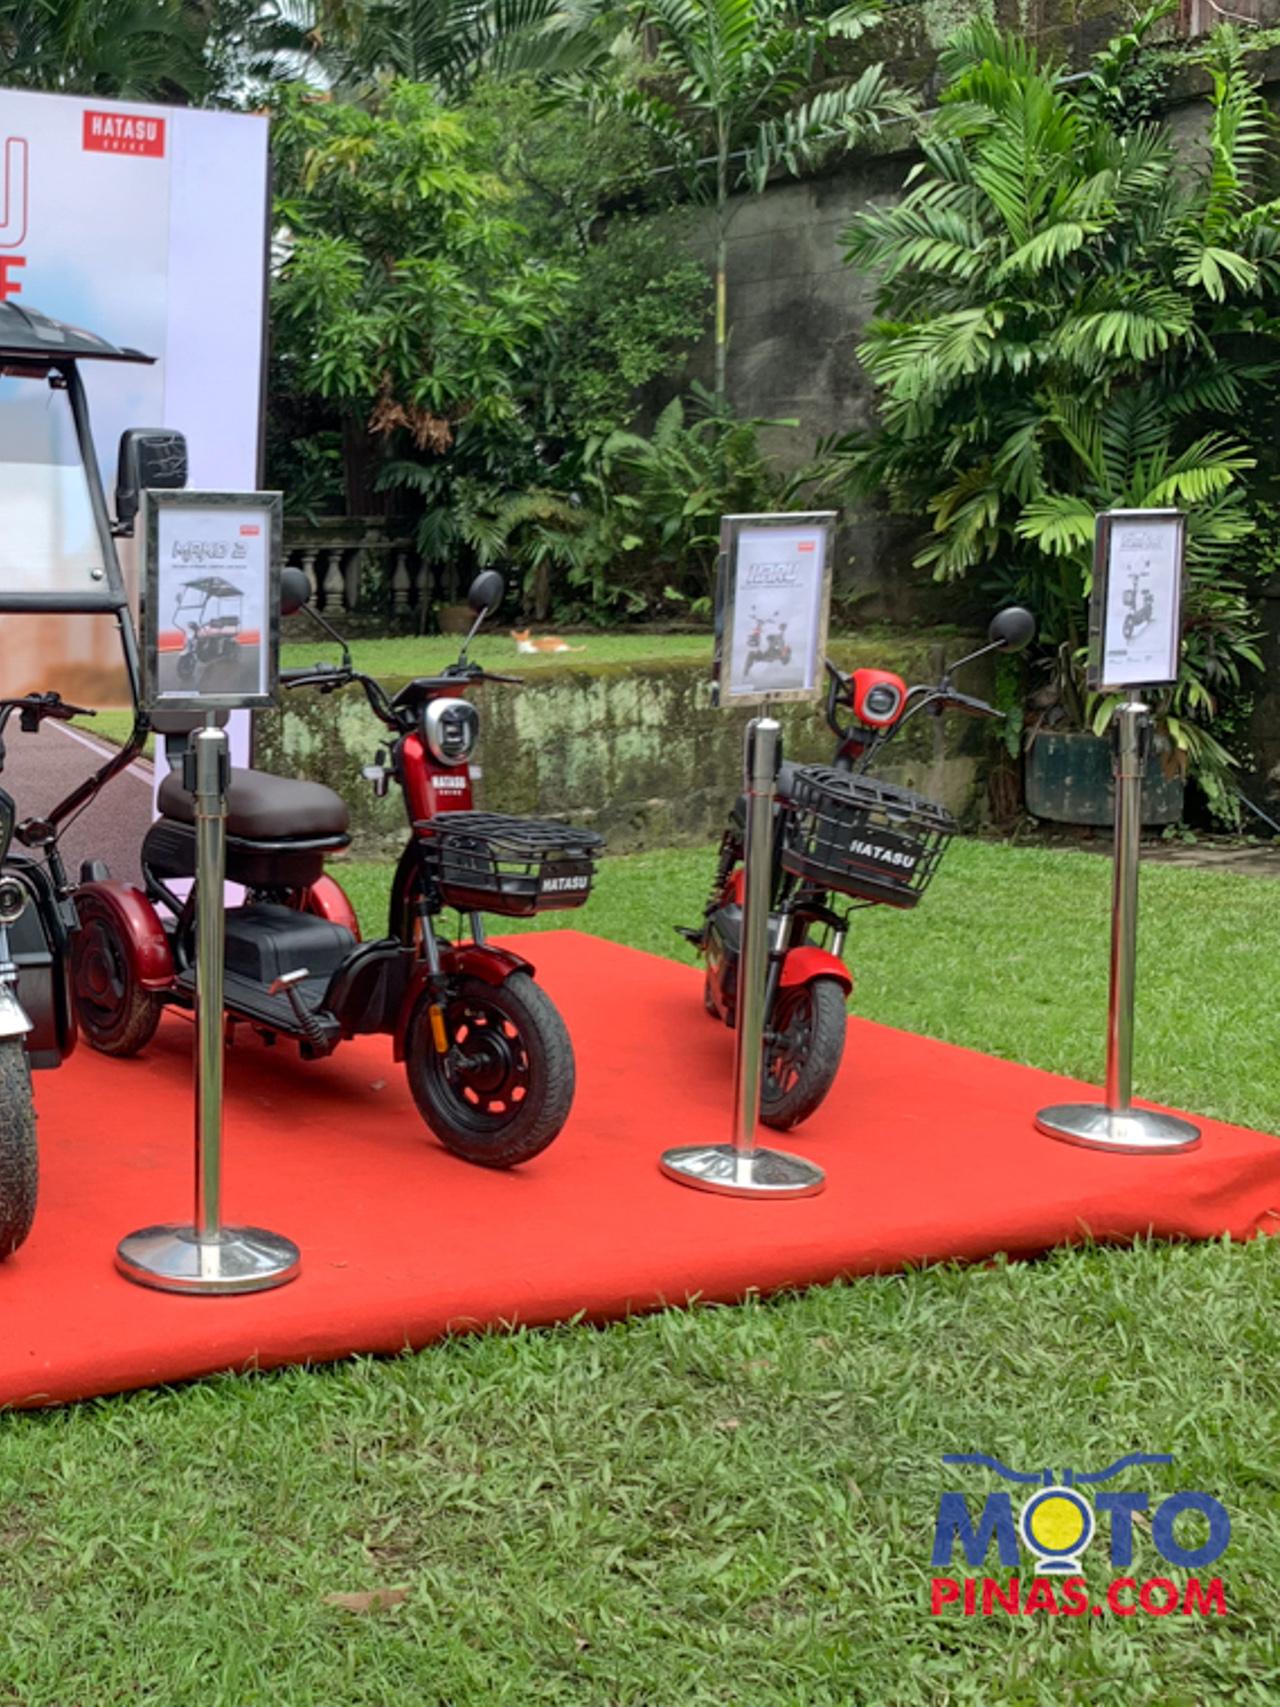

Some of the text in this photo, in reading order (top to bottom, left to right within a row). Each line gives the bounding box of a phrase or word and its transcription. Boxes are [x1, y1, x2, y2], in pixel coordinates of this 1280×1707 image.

[92, 115, 158, 142] HATASU
[849, 840, 915, 868] HATASU
[542, 875, 588, 892] HATASU
